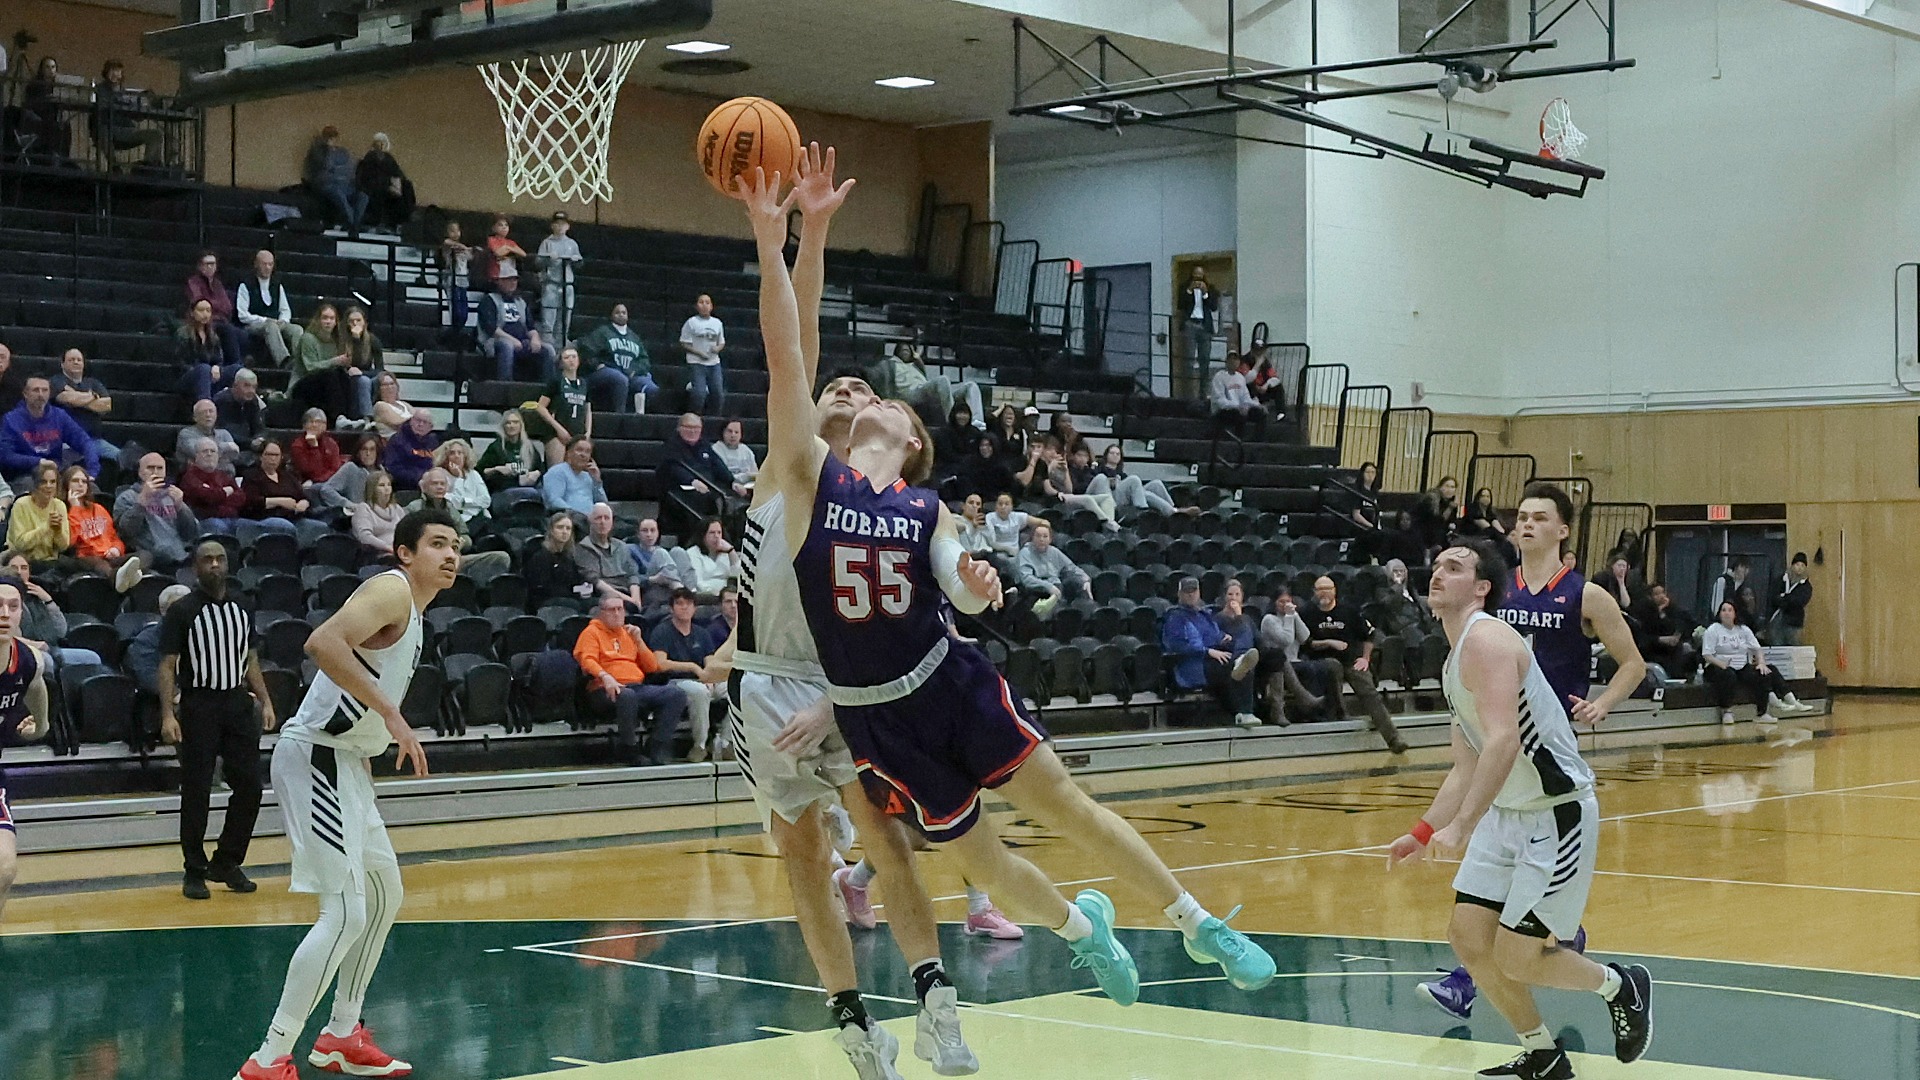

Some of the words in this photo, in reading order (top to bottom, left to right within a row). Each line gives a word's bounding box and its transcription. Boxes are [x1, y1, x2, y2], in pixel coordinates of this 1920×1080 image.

[823, 501, 923, 543] HOBART
[831, 540, 916, 623] 55
[1496, 608, 1564, 629] HOBART
